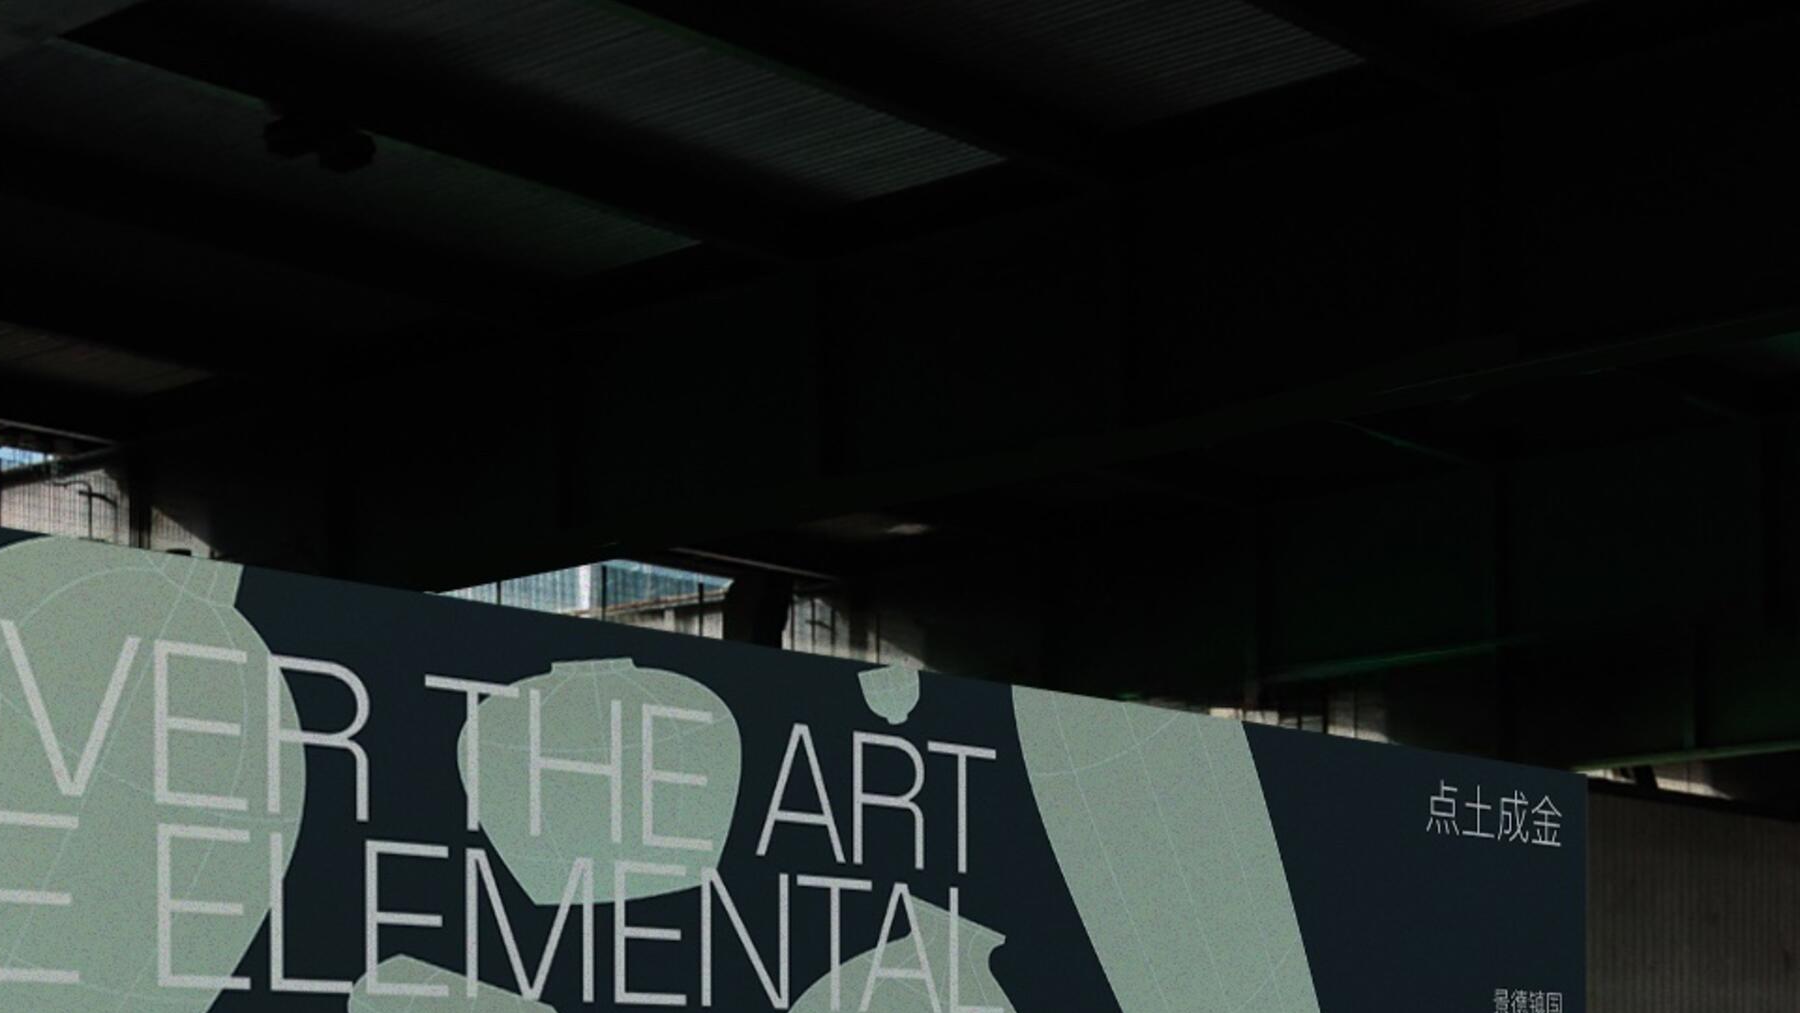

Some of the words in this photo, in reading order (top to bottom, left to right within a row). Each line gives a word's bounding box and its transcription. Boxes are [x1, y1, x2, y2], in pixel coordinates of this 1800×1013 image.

[424, 674, 714, 852] THE
[756, 722, 997, 874] ART
[1425, 779, 1563, 848] 点土成金
